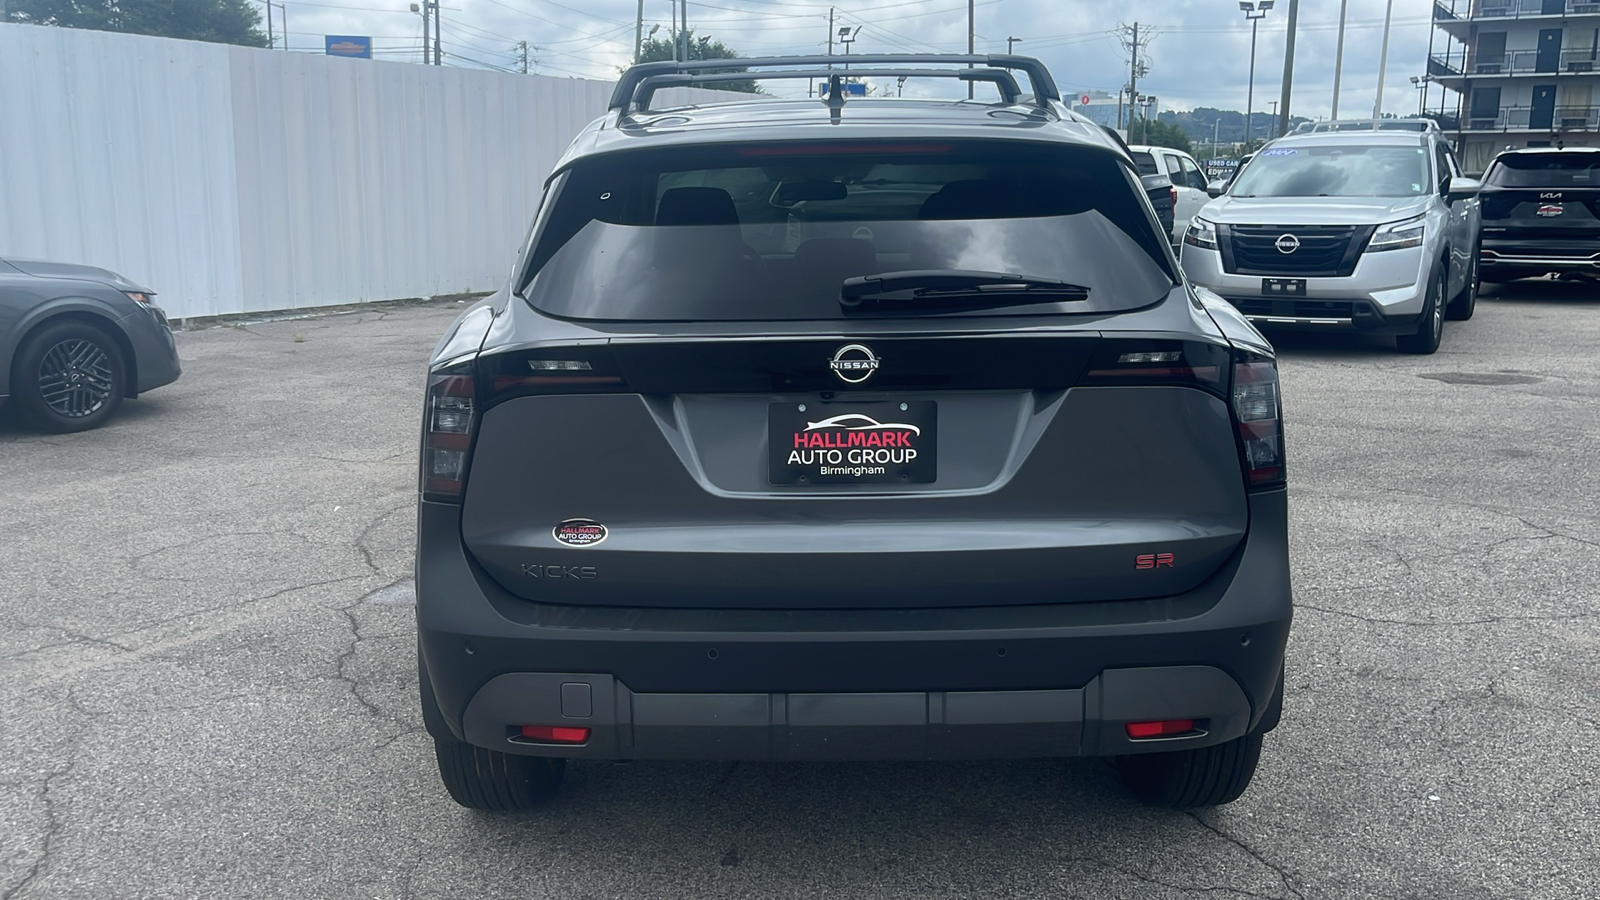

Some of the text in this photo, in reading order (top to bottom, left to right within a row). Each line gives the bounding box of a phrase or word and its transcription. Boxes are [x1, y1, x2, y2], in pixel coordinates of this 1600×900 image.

[830, 361, 879, 369] NISSAN
[794, 431, 912, 448] HALLMARK
[787, 448, 917, 464] AUTO GROUP
[820, 465, 885, 476] Birmingham
[1135, 552, 1174, 569] SR
[521, 563, 598, 580] KICKS
